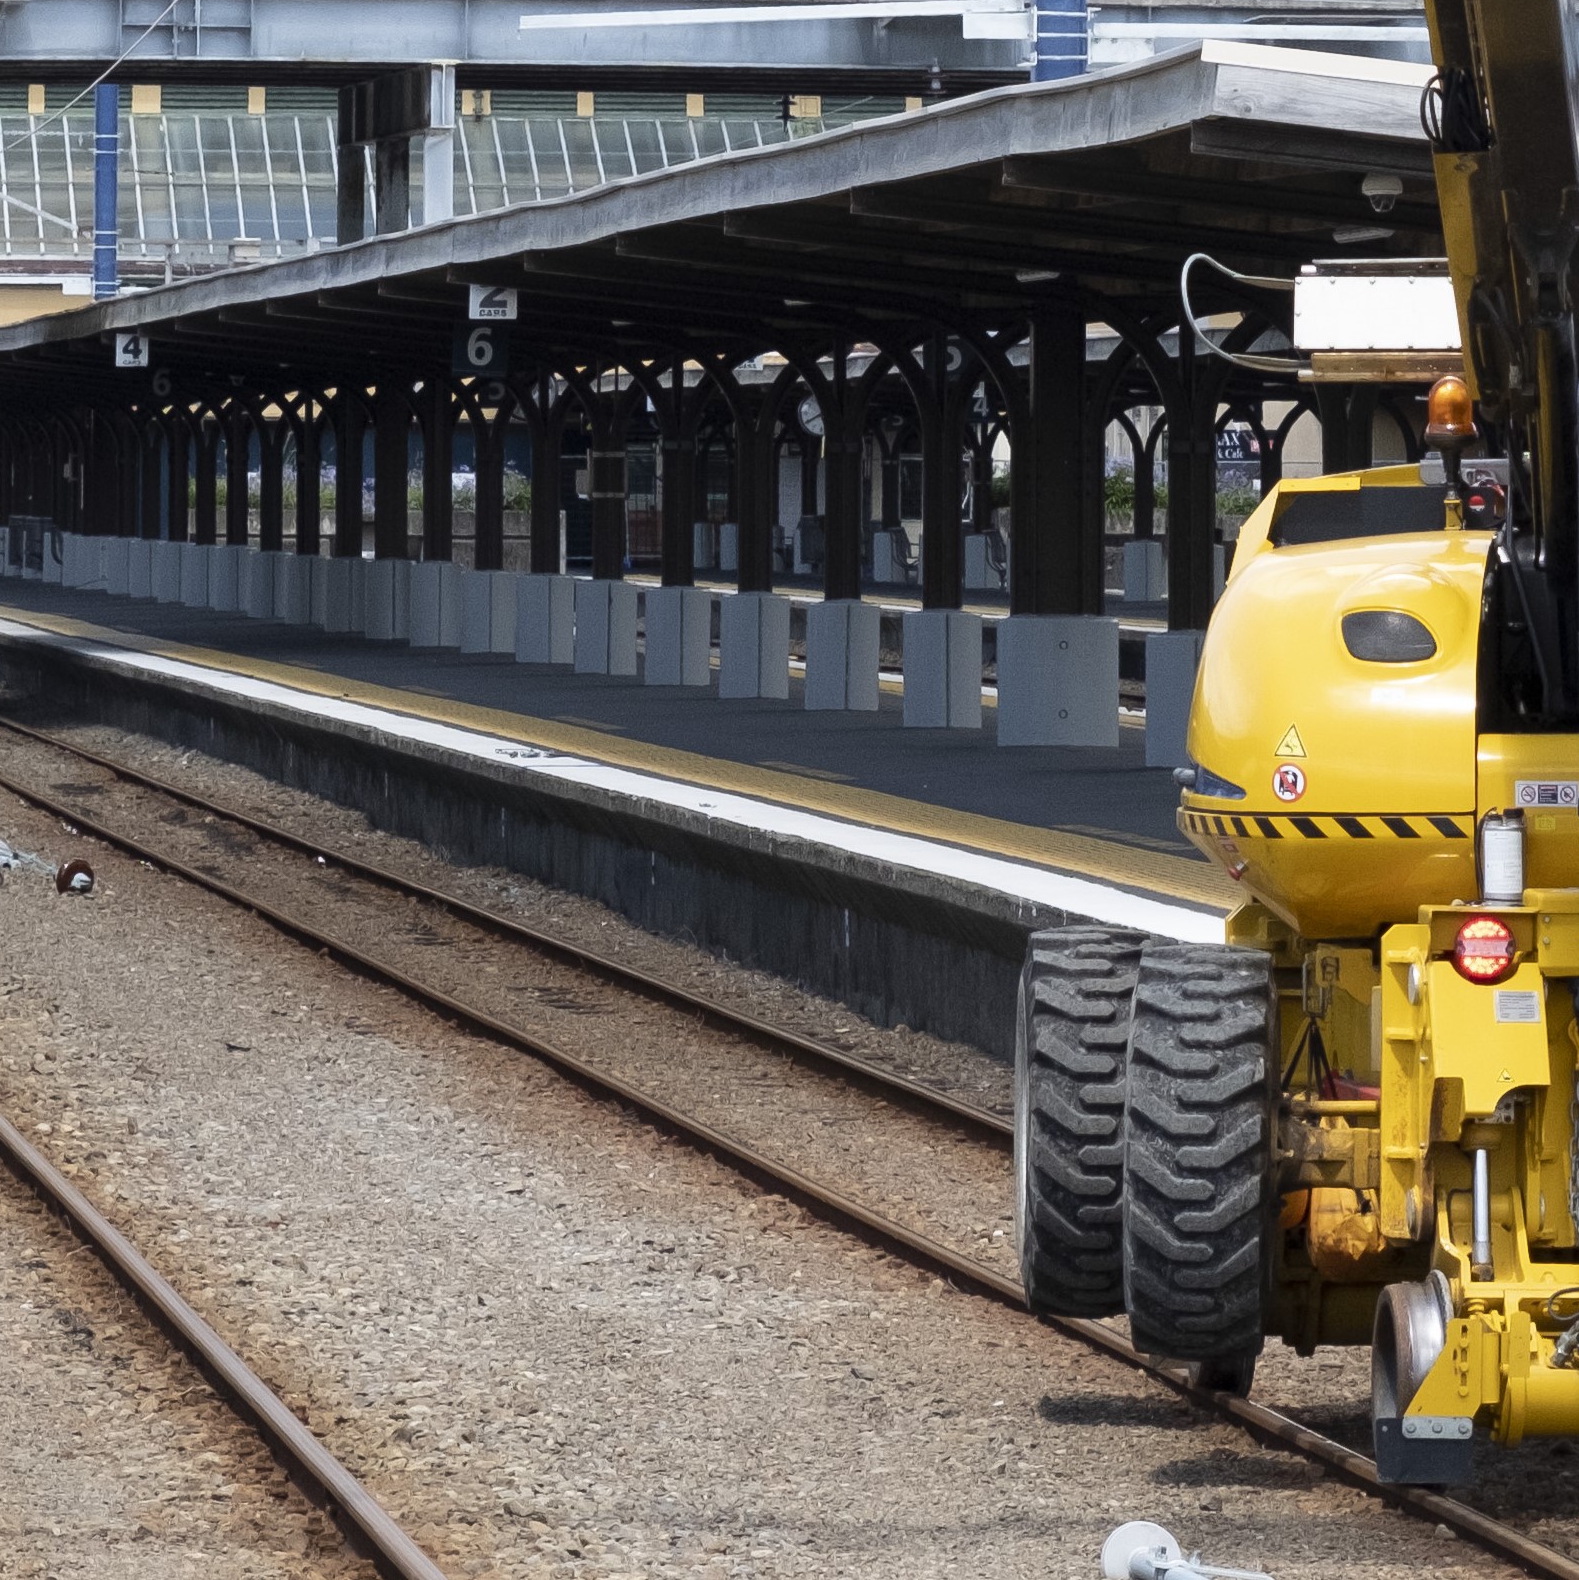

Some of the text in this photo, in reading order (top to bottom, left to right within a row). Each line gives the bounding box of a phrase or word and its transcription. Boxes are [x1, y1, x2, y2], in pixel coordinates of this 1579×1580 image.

[122, 335, 142, 359] 4
[467, 327, 493, 366] 6
[153, 368, 171, 397] 6
[973, 397, 989, 417] 4
